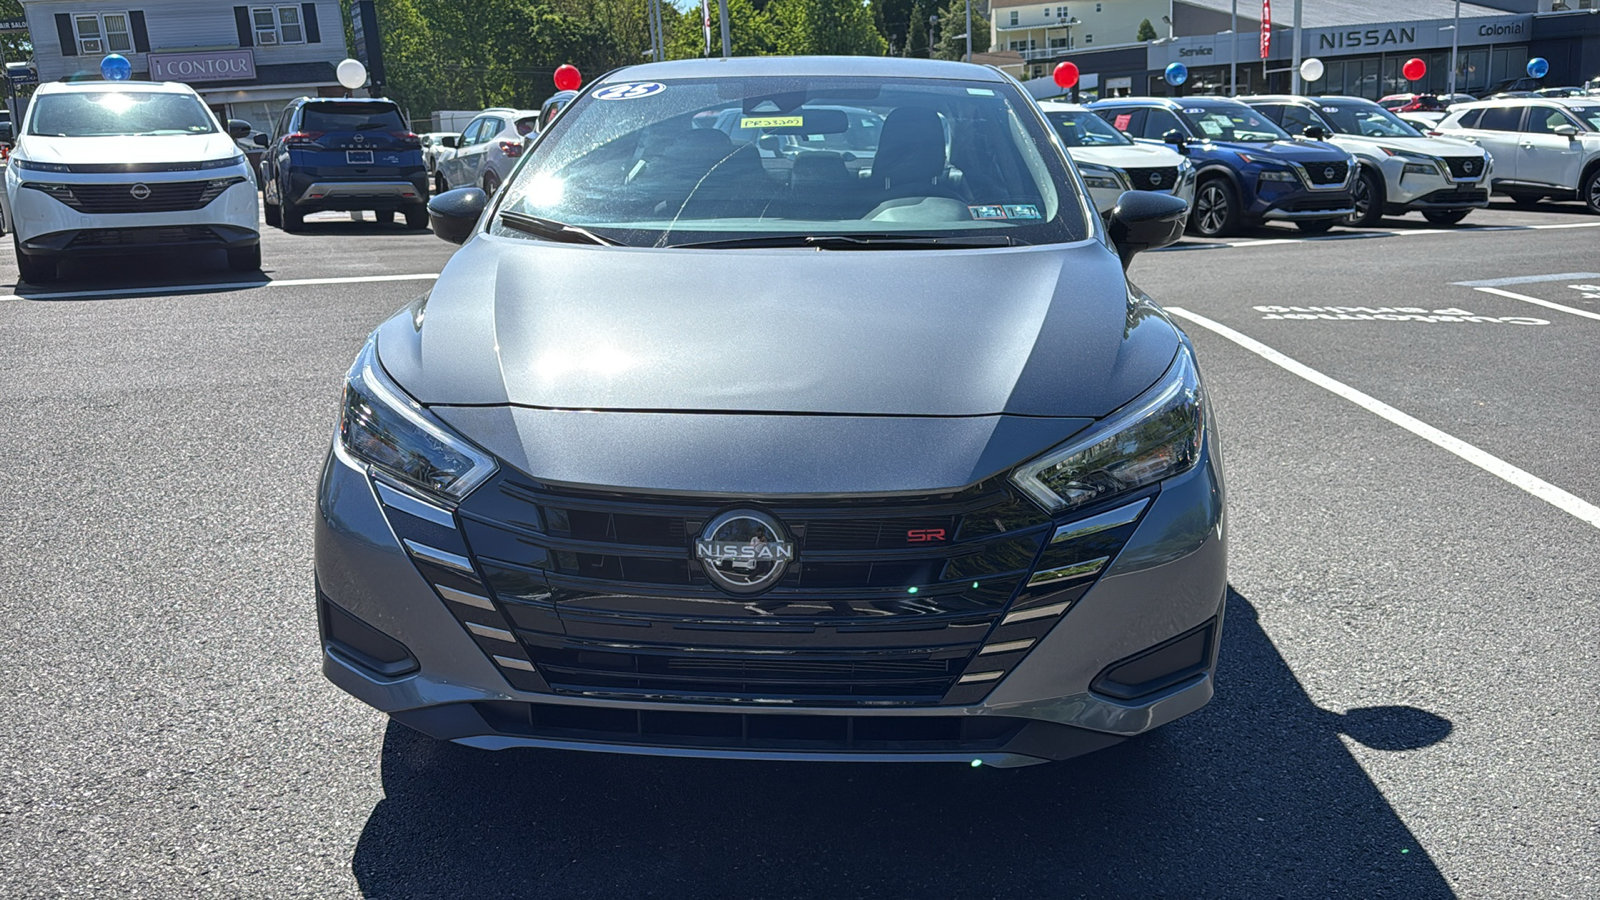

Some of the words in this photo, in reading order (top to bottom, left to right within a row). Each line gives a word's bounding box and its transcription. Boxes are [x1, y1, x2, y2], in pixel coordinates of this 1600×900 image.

[1479, 21, 1524, 36] Colonial
[1320, 27, 1415, 49] NISSAN
[1179, 46, 1213, 57] Service
[167, 58, 248, 75] CONTOUR
[600, 83, 655, 98] 25
[1252, 306, 1474, 315] Parking
[1262, 314, 1550, 325] Customer
[907, 528, 946, 542] SR
[696, 544, 792, 558] NISSAN
